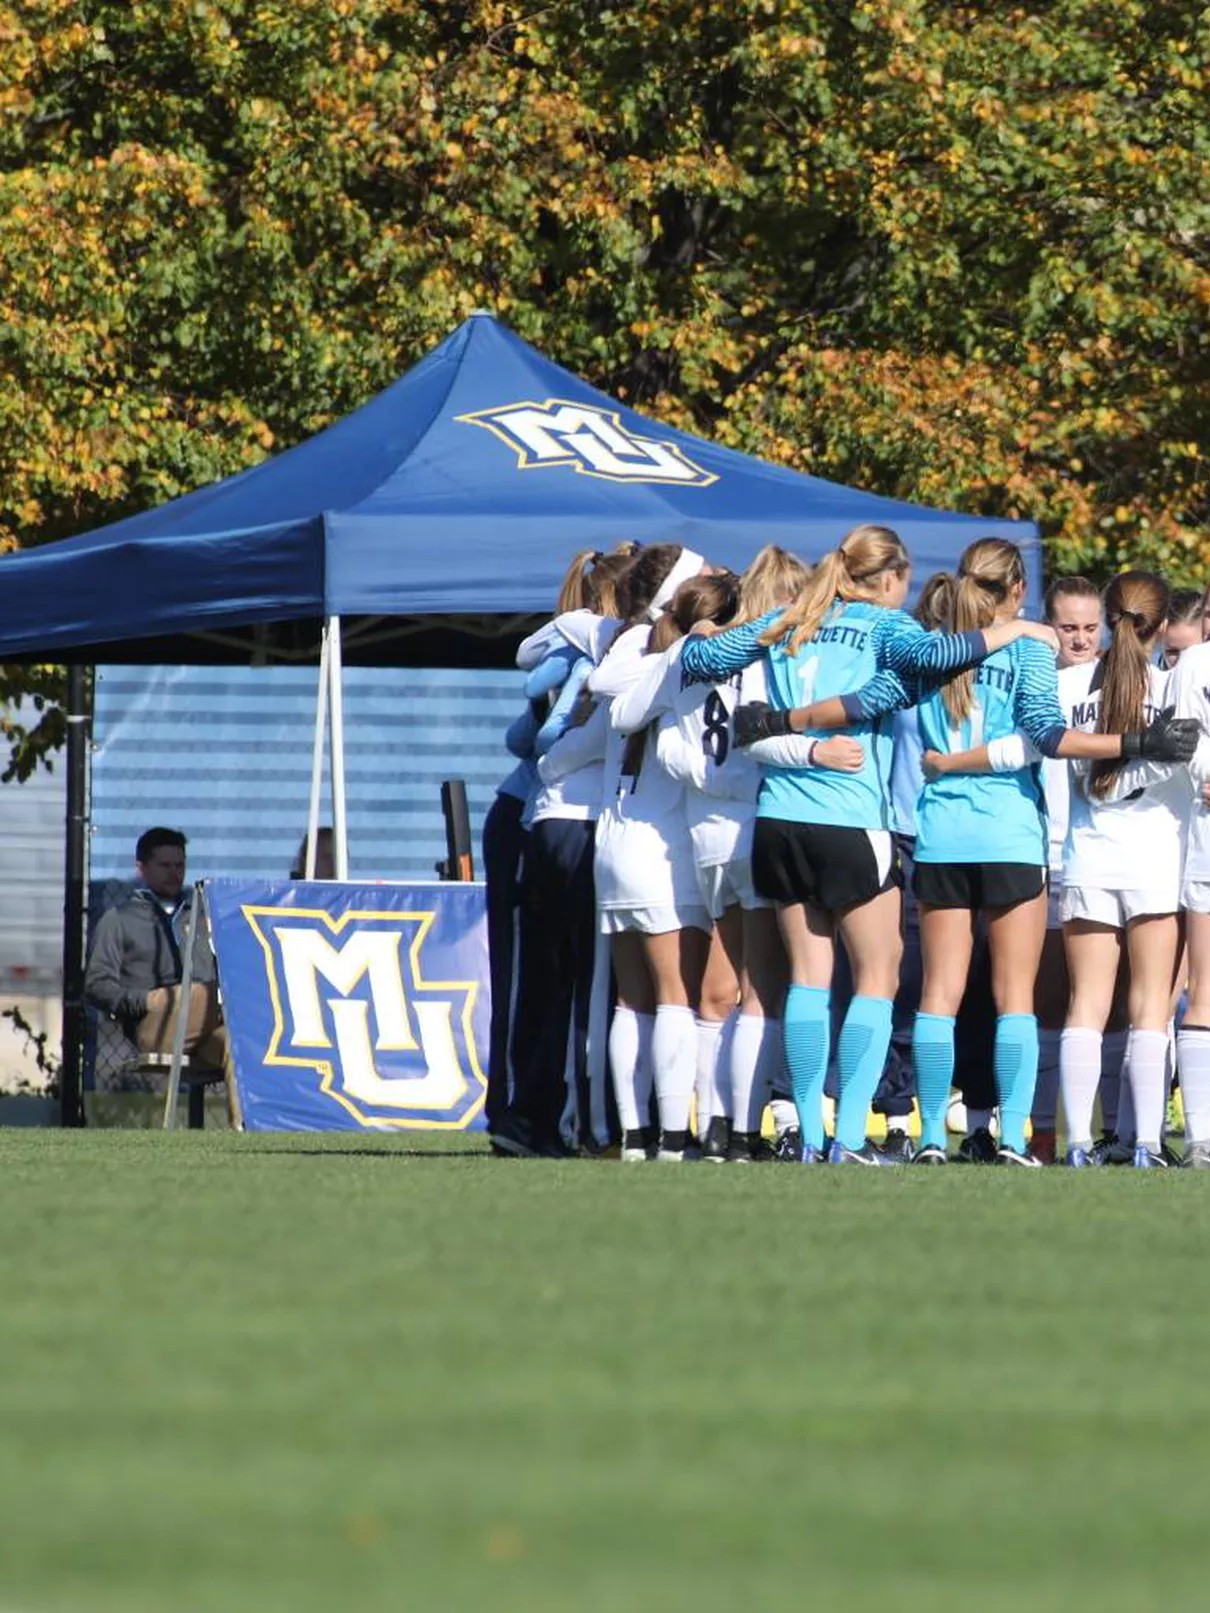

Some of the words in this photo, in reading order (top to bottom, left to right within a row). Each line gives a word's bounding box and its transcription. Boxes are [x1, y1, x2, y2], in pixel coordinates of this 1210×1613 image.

[491, 406, 698, 480] MU
[702, 690, 729, 767] 8
[273, 926, 470, 1110] MU
